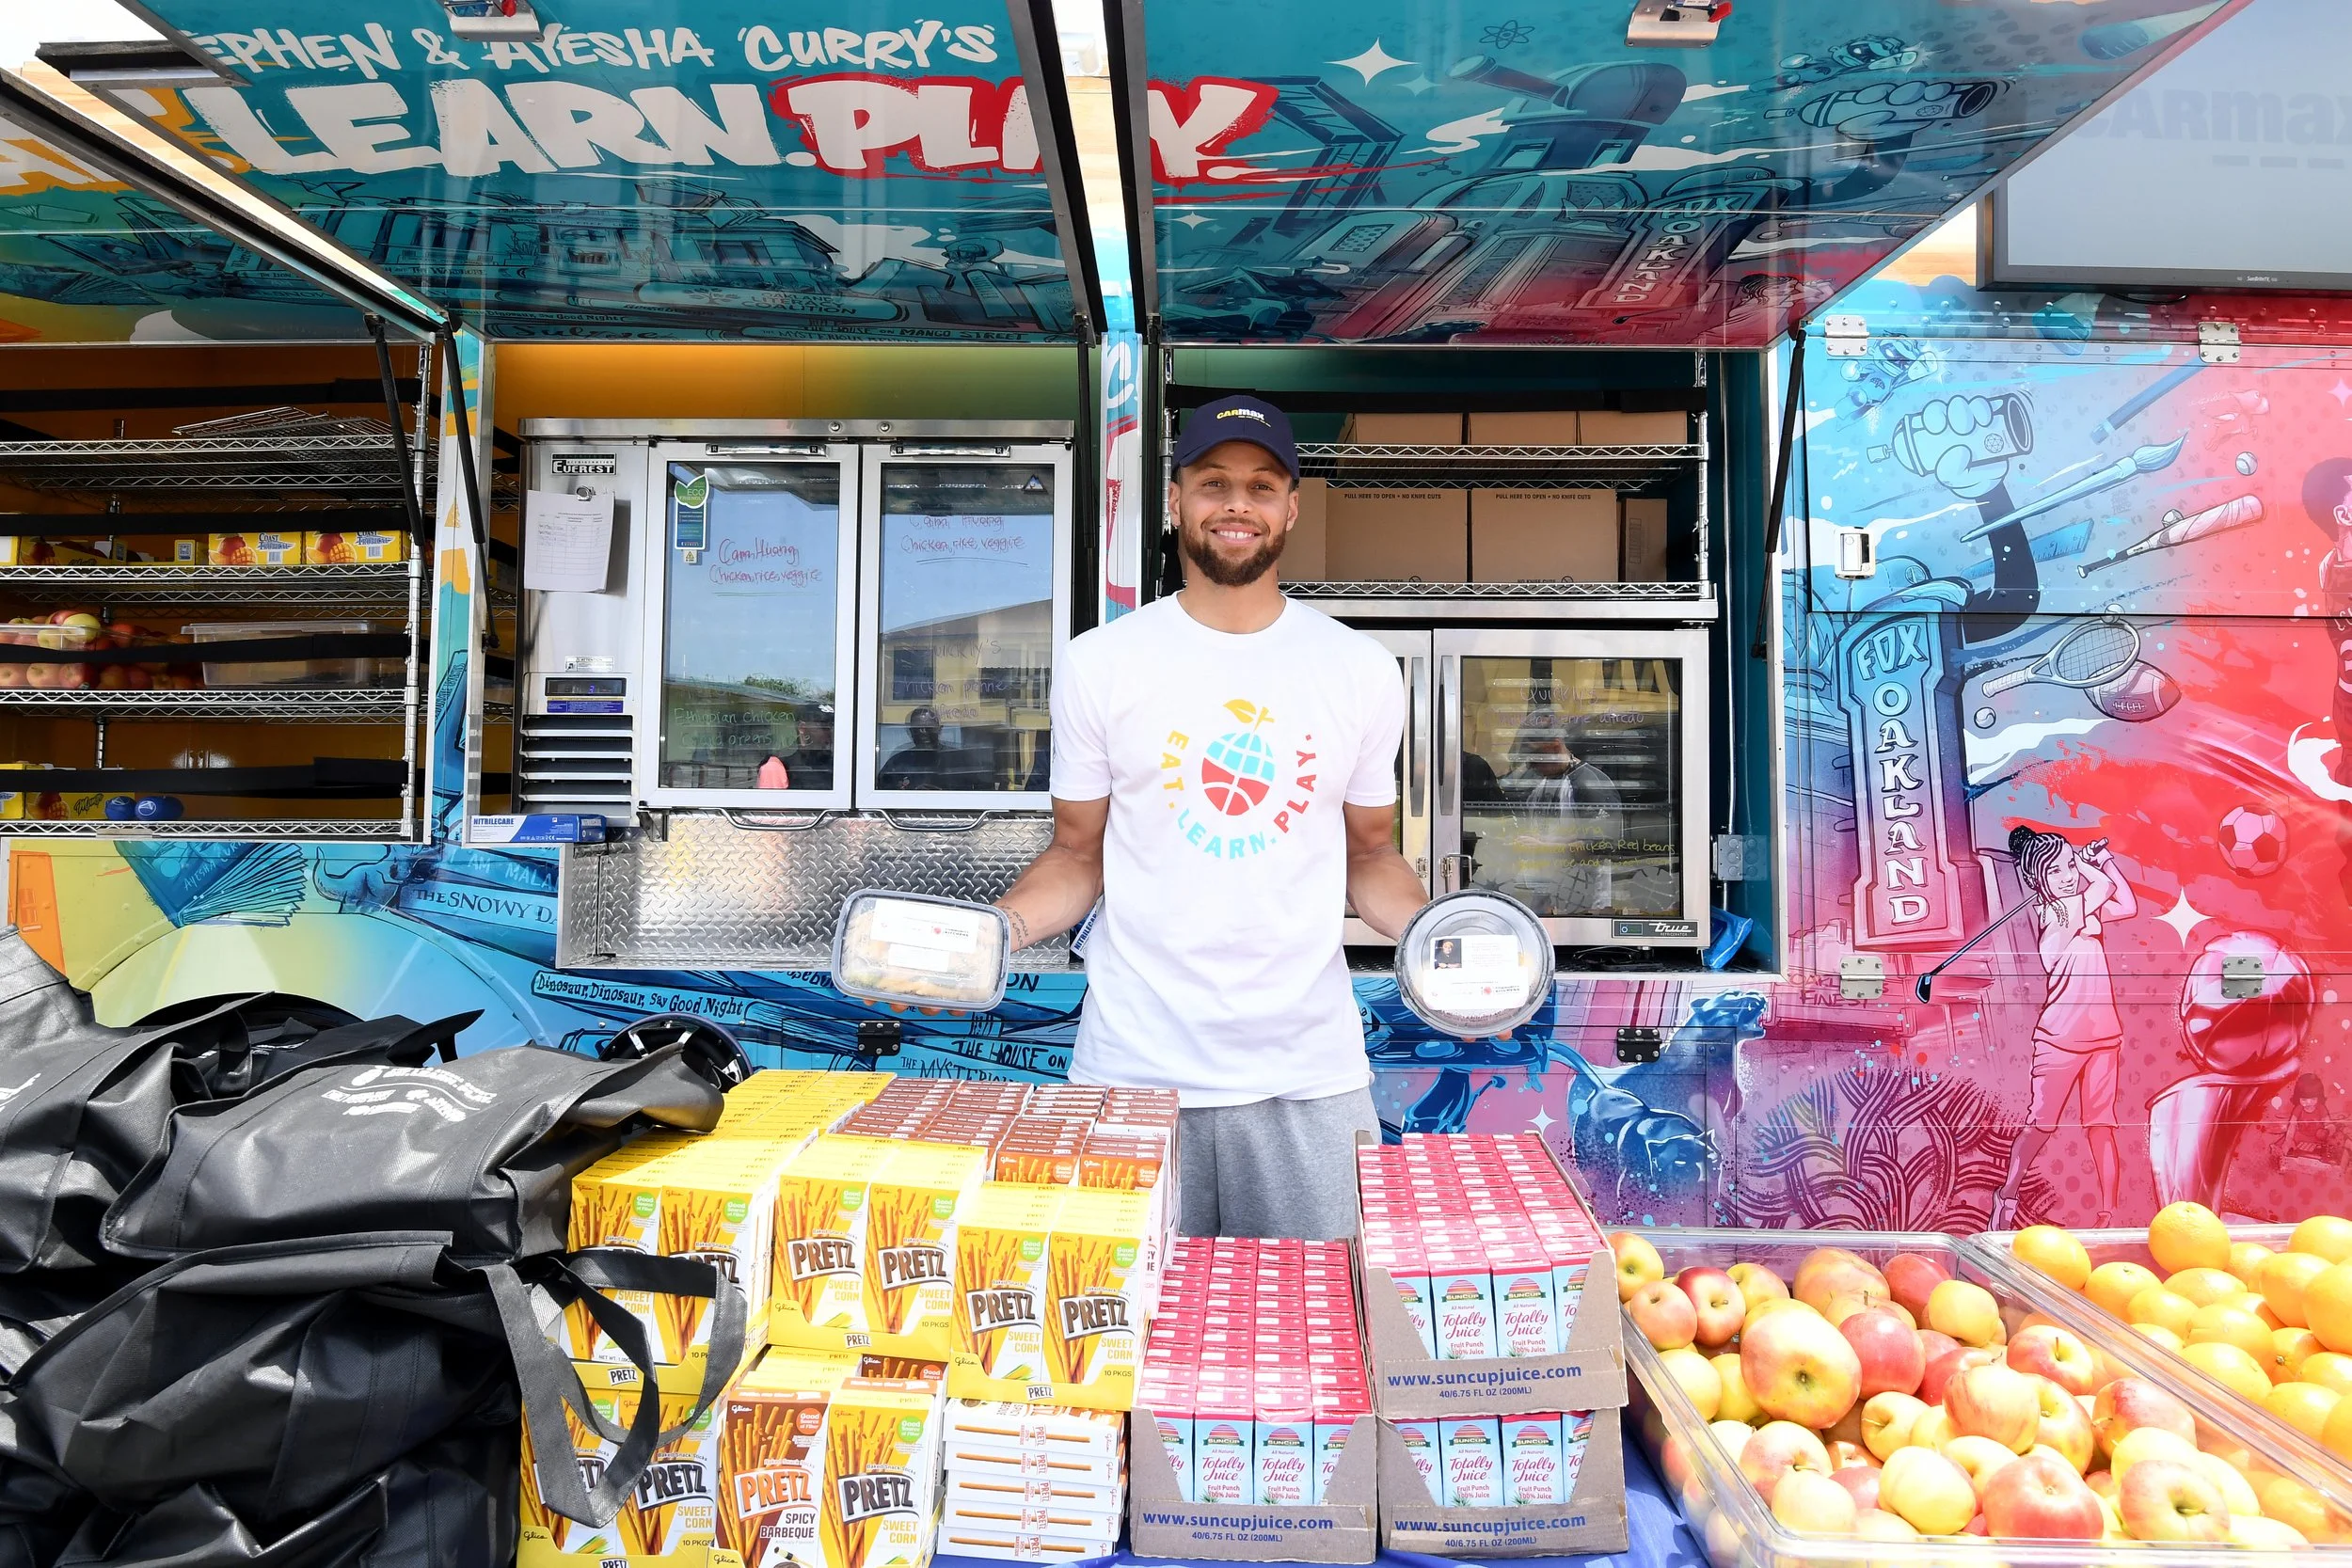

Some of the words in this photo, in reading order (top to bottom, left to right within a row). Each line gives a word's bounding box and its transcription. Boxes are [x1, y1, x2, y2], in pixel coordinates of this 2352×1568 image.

[411, 28, 461, 65] &
[483, 24, 713, 71] AYESHA
[739, 19, 997, 71] CURRY'S
[1661, 196, 1732, 218] FOX
[1613, 220, 1701, 303] OAKLAND
[742, 300, 857, 314] COALITION
[687, 488, 705, 497] ECO
[1856, 625, 1929, 681] FOX
[1872, 681, 1931, 927] OAKLAND
[468, 854, 490, 873] AM
[505, 863, 559, 892] MALA
[412, 889, 446, 904] THE
[447, 891, 531, 918] SNOWY
[537, 974, 588, 998] Dinosaur,
[589, 983, 645, 1007] Dinosaur,
[649, 993, 667, 1007] Say
[668, 993, 701, 1014] Good
[704, 997, 744, 1018] Night
[1048, 1053, 1068, 1069] ON
[792, 1242, 855, 1275] PRETZ
[883, 1250, 947, 1284] PRETZ
[828, 1279, 860, 1290] SWEET
[618, 1291, 651, 1303] SWEET
[834, 1290, 860, 1301] CORN
[919, 1289, 950, 1299] SWEET
[625, 1302, 650, 1314] CORN
[775, 1303, 798, 1312] Glico
[926, 1299, 950, 1310] CORN
[972, 1292, 1036, 1325] PRETZ
[1064, 1299, 1129, 1334] PRETZ
[1442, 1311, 1486, 1327] Totally
[1504, 1309, 1549, 1325] Totally
[1008, 1332, 1040, 1341] SWEET
[1446, 1323, 1481, 1339] Juice
[1507, 1322, 1543, 1337] Juice
[847, 1335, 870, 1346] PRETZ
[1014, 1342, 1040, 1353] CORN
[1101, 1338, 1133, 1348] SWEET
[1107, 1348, 1133, 1359] CORN
[955, 1356, 977, 1366] Glico
[610, 1370, 637, 1384] PRETZ
[1388, 1365, 1581, 1386] www.suncupjuice.com
[1028, 1386, 1053, 1398] PRETZ
[1500, 1386, 1532, 1396] (200ML)
[1035, 1426, 1045, 1447] PRETZ
[1036, 1454, 1047, 1475] PRETZ
[1202, 1456, 1246, 1472] Totally
[1263, 1458, 1305, 1473] Totally
[1450, 1456, 1493, 1471] Totally
[1513, 1457, 1555, 1472] Totally
[1203, 1468, 1238, 1481] Juice
[1263, 1469, 1298, 1482] Juice
[1453, 1468, 1487, 1482] Juice
[1514, 1469, 1549, 1483] Juice
[639, 1465, 707, 1504] PRETZ
[1039, 1481, 1050, 1502] PRETZ
[739, 1473, 812, 1511] PRETZ
[843, 1478, 914, 1516] PRETZ
[677, 1506, 712, 1516] SWEET
[685, 1517, 712, 1528] CORN
[786, 1513, 816, 1524] SPICY
[882, 1520, 917, 1531] SWEET
[1036, 1510, 1047, 1530] PRETZ
[1142, 1512, 1333, 1531] www.suncupjuice.com
[1395, 1513, 1586, 1536] www.suncupjuice.com
[524, 1531, 548, 1540] Glico
[760, 1526, 815, 1539] BARBEQUE
[890, 1531, 916, 1544] CORN
[1250, 1532, 1283, 1542] (200ML)
[1030, 1537, 1041, 1558] PRETZ
[1445, 1538, 1477, 1547] 40/6.75
[1479, 1538, 1489, 1547] FL
[1492, 1538, 1502, 1546] OZ
[1505, 1537, 1537, 1546] (200ML)
[713, 1554, 738, 1564] Glico
